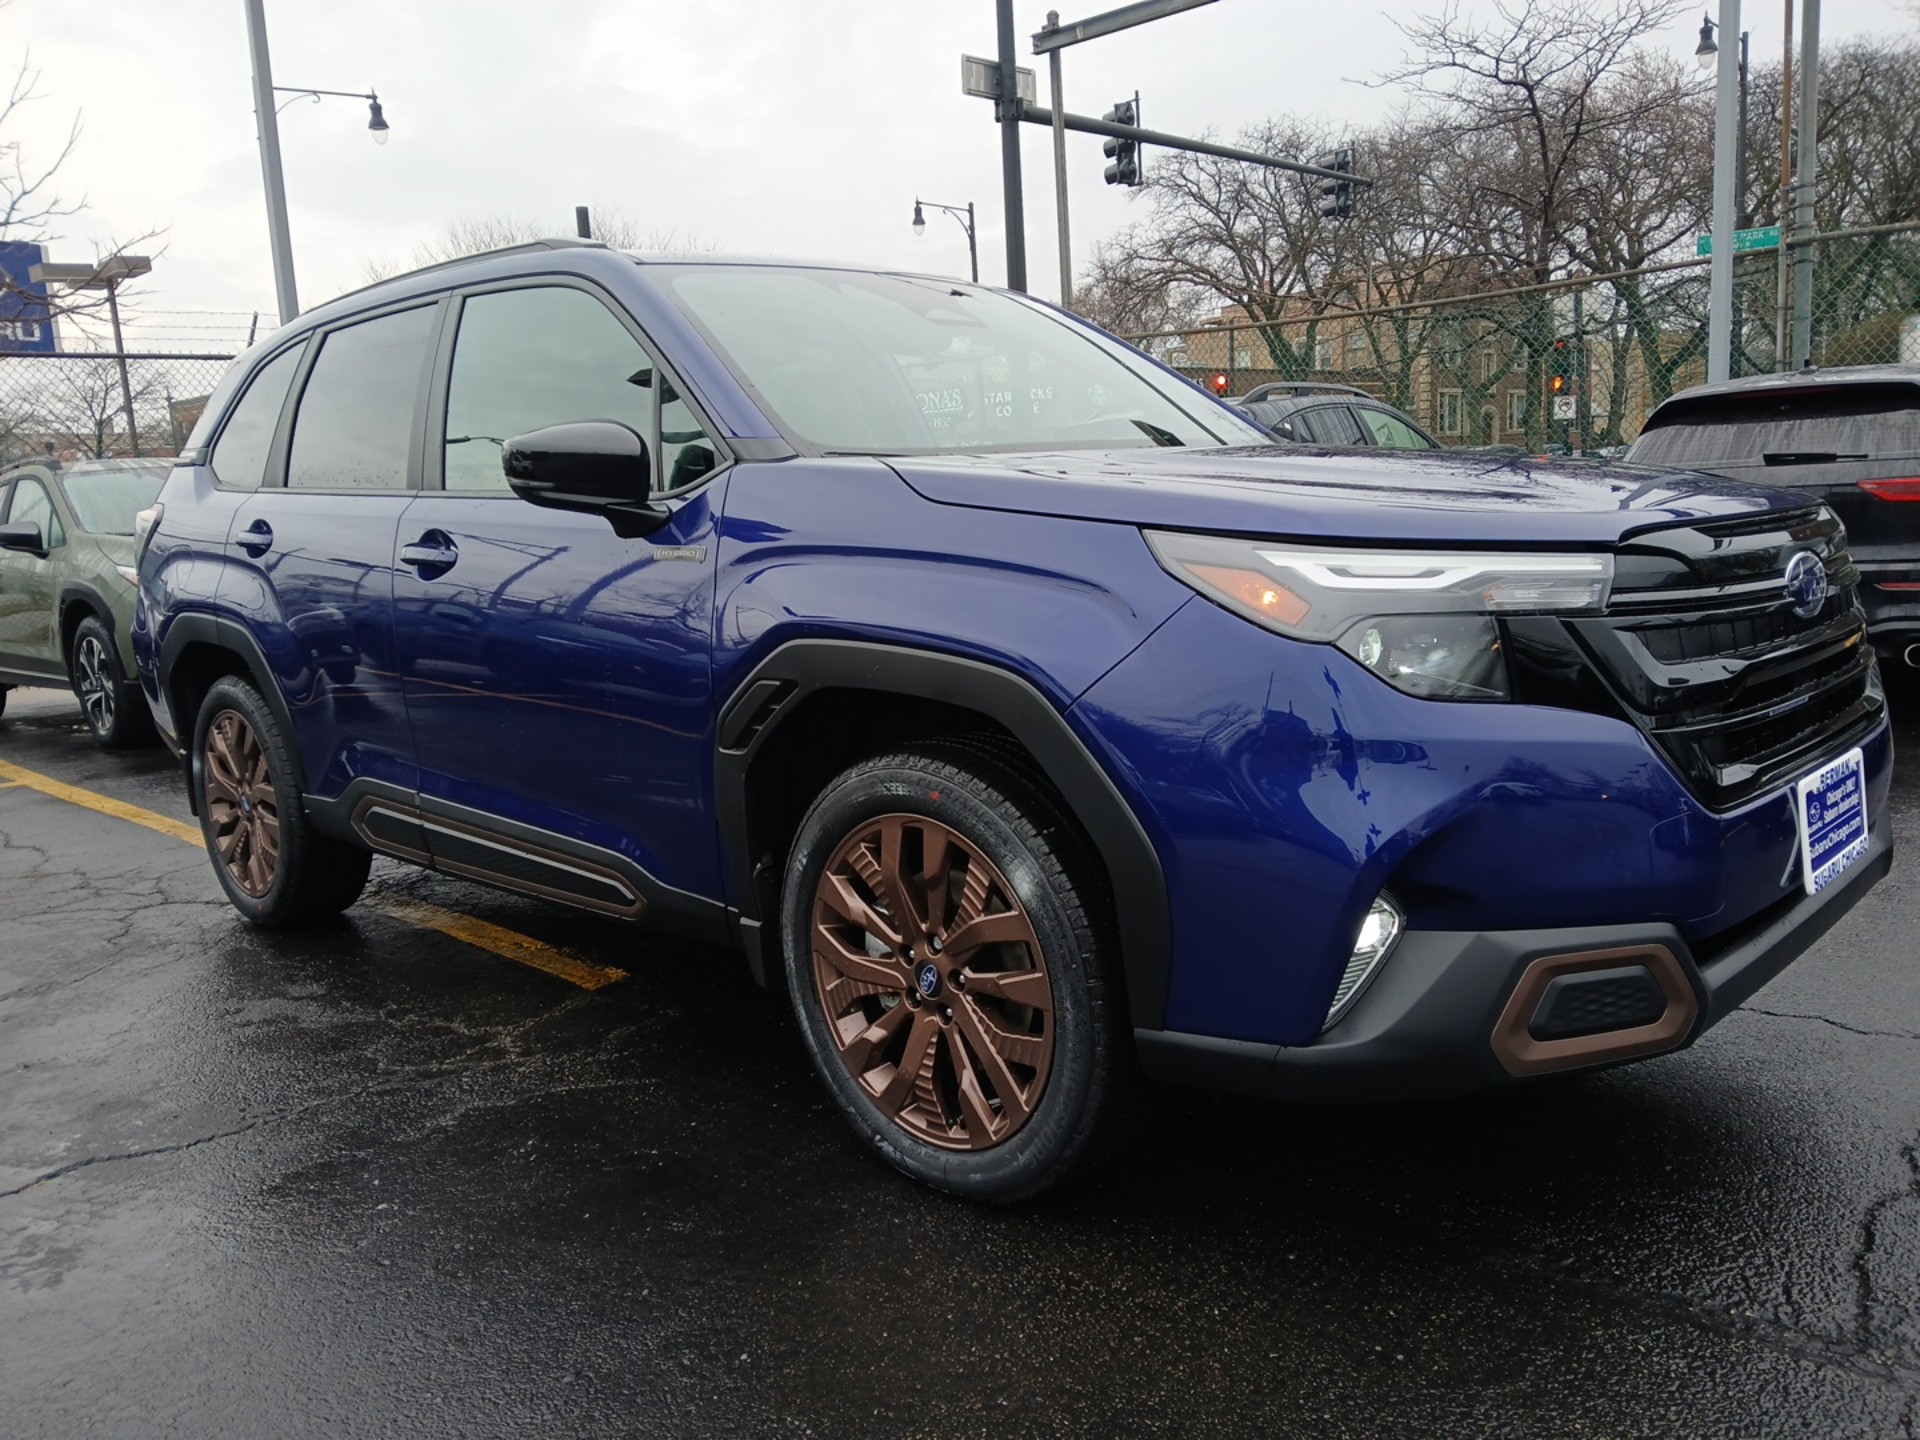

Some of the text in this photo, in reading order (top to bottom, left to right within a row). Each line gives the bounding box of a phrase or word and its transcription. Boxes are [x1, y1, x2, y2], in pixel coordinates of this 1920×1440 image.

[662, 549, 696, 557] HYBRID
[1814, 836, 1868, 893] SUBARU CHICAGO
